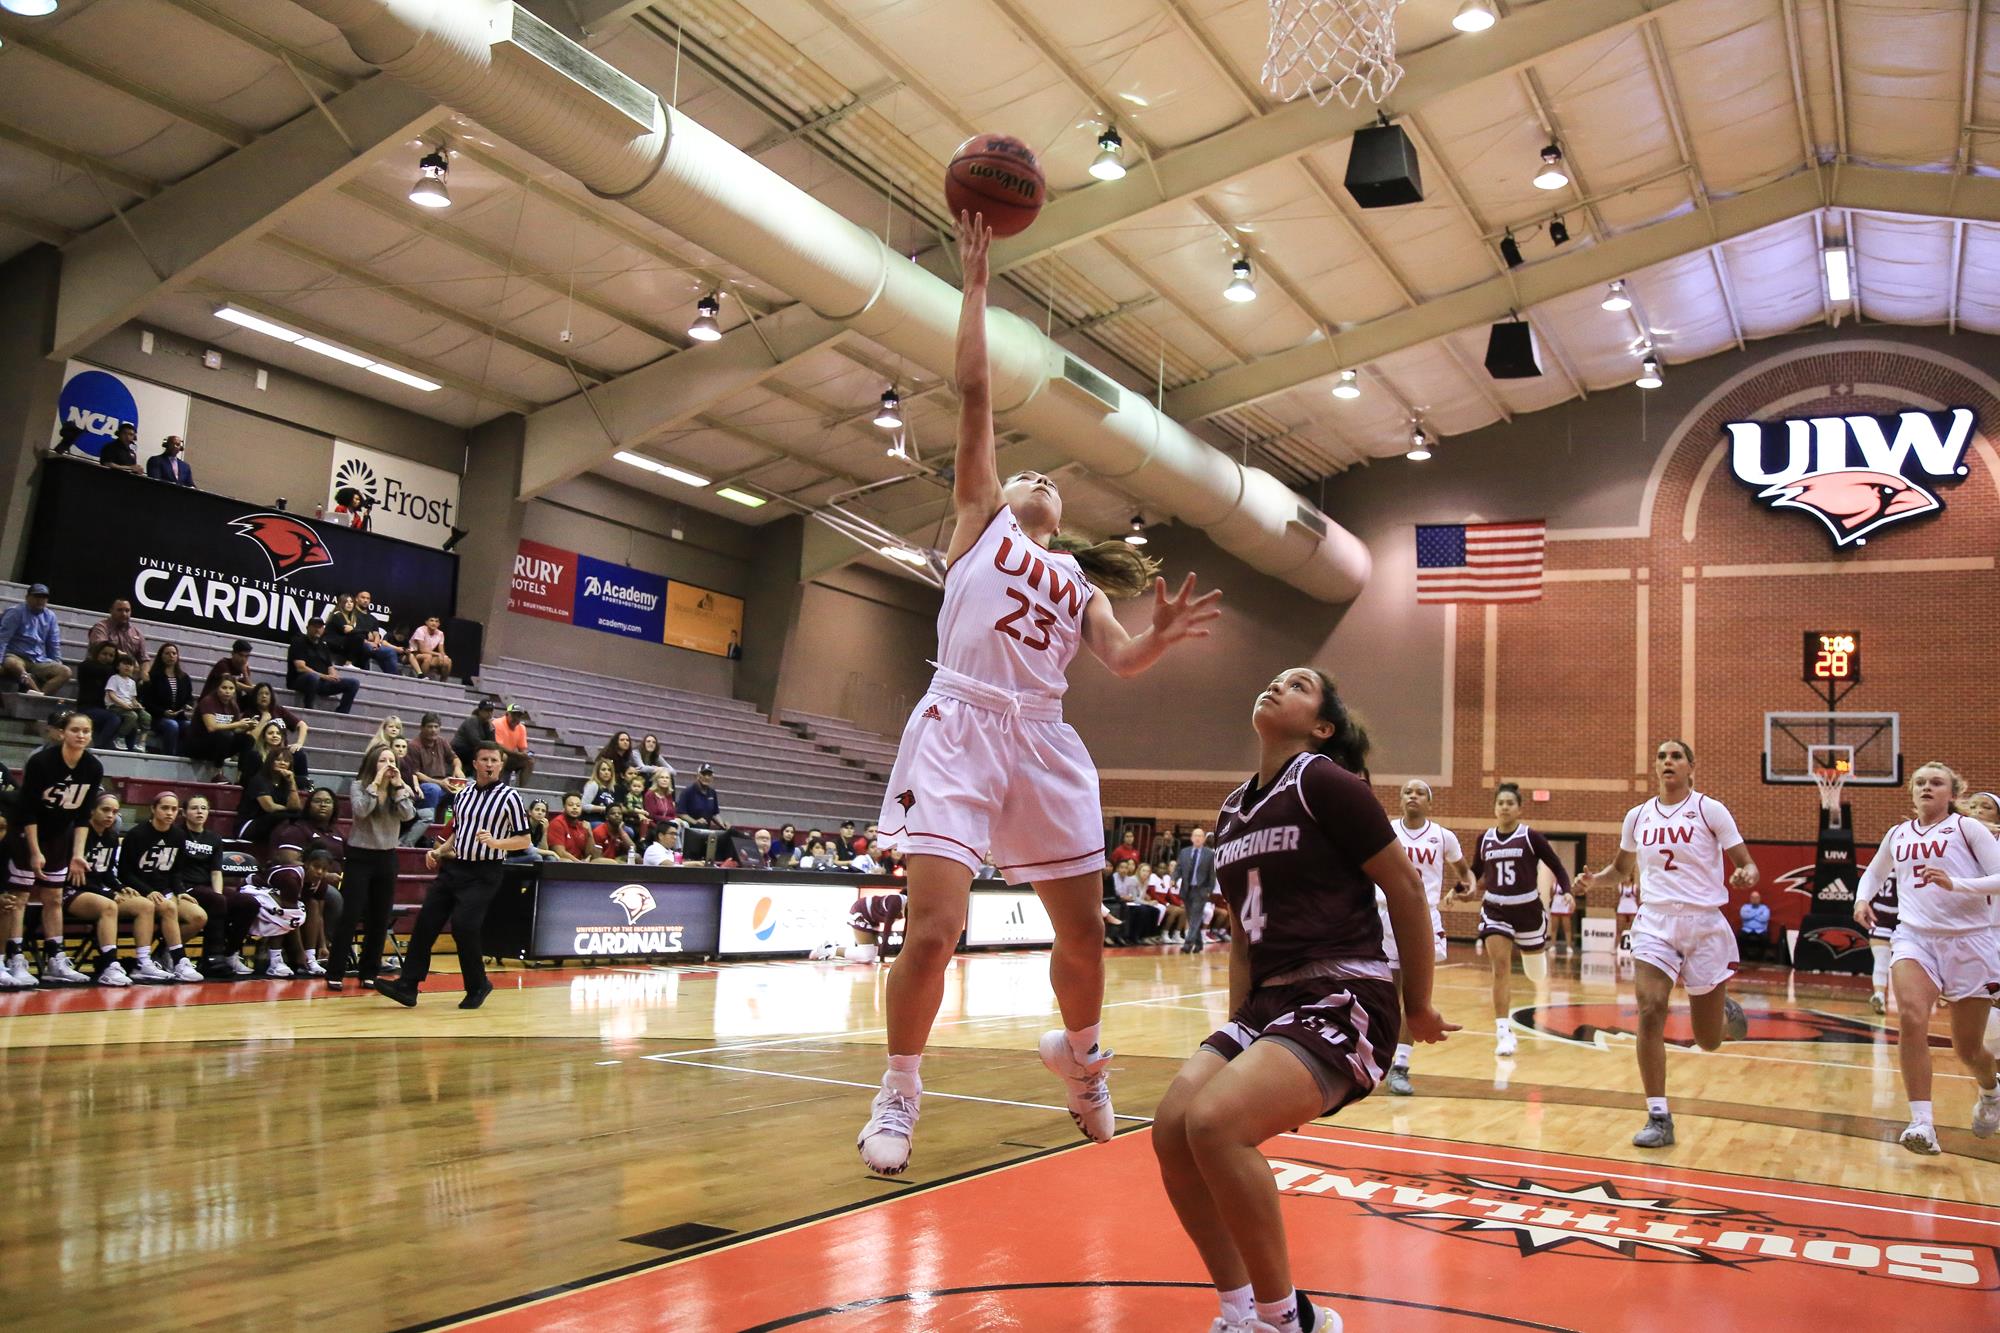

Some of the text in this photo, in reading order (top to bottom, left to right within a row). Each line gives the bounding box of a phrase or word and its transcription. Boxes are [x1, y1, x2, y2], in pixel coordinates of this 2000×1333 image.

[67, 405, 134, 439] NCA
[1727, 408, 1973, 485] UIW
[381, 477, 452, 528] Frost
[139, 556, 390, 614] UNIVERSITY OF THE INCARNA ORD
[994, 536, 1081, 619] UIW
[134, 568, 390, 641] CARDIN
[603, 580, 657, 610] Academy
[598, 618, 642, 633] academy.com
[995, 586, 1057, 651] 23
[1815, 652, 1848, 676] 28
[1642, 826, 1694, 846] UIW
[1405, 846, 1437, 865] IW
[1659, 849, 1678, 871] 2
[1824, 850, 1848, 859] UIW
[1896, 840, 1948, 862] UIW
[1496, 860, 1516, 886] 15
[1913, 864, 1929, 888] 5
[1241, 867, 1267, 944] 4
[1818, 890, 1854, 900] adidas
[574, 933, 682, 955] CARDINALS
[1365, 1174, 1826, 1238] CONFERENCE
